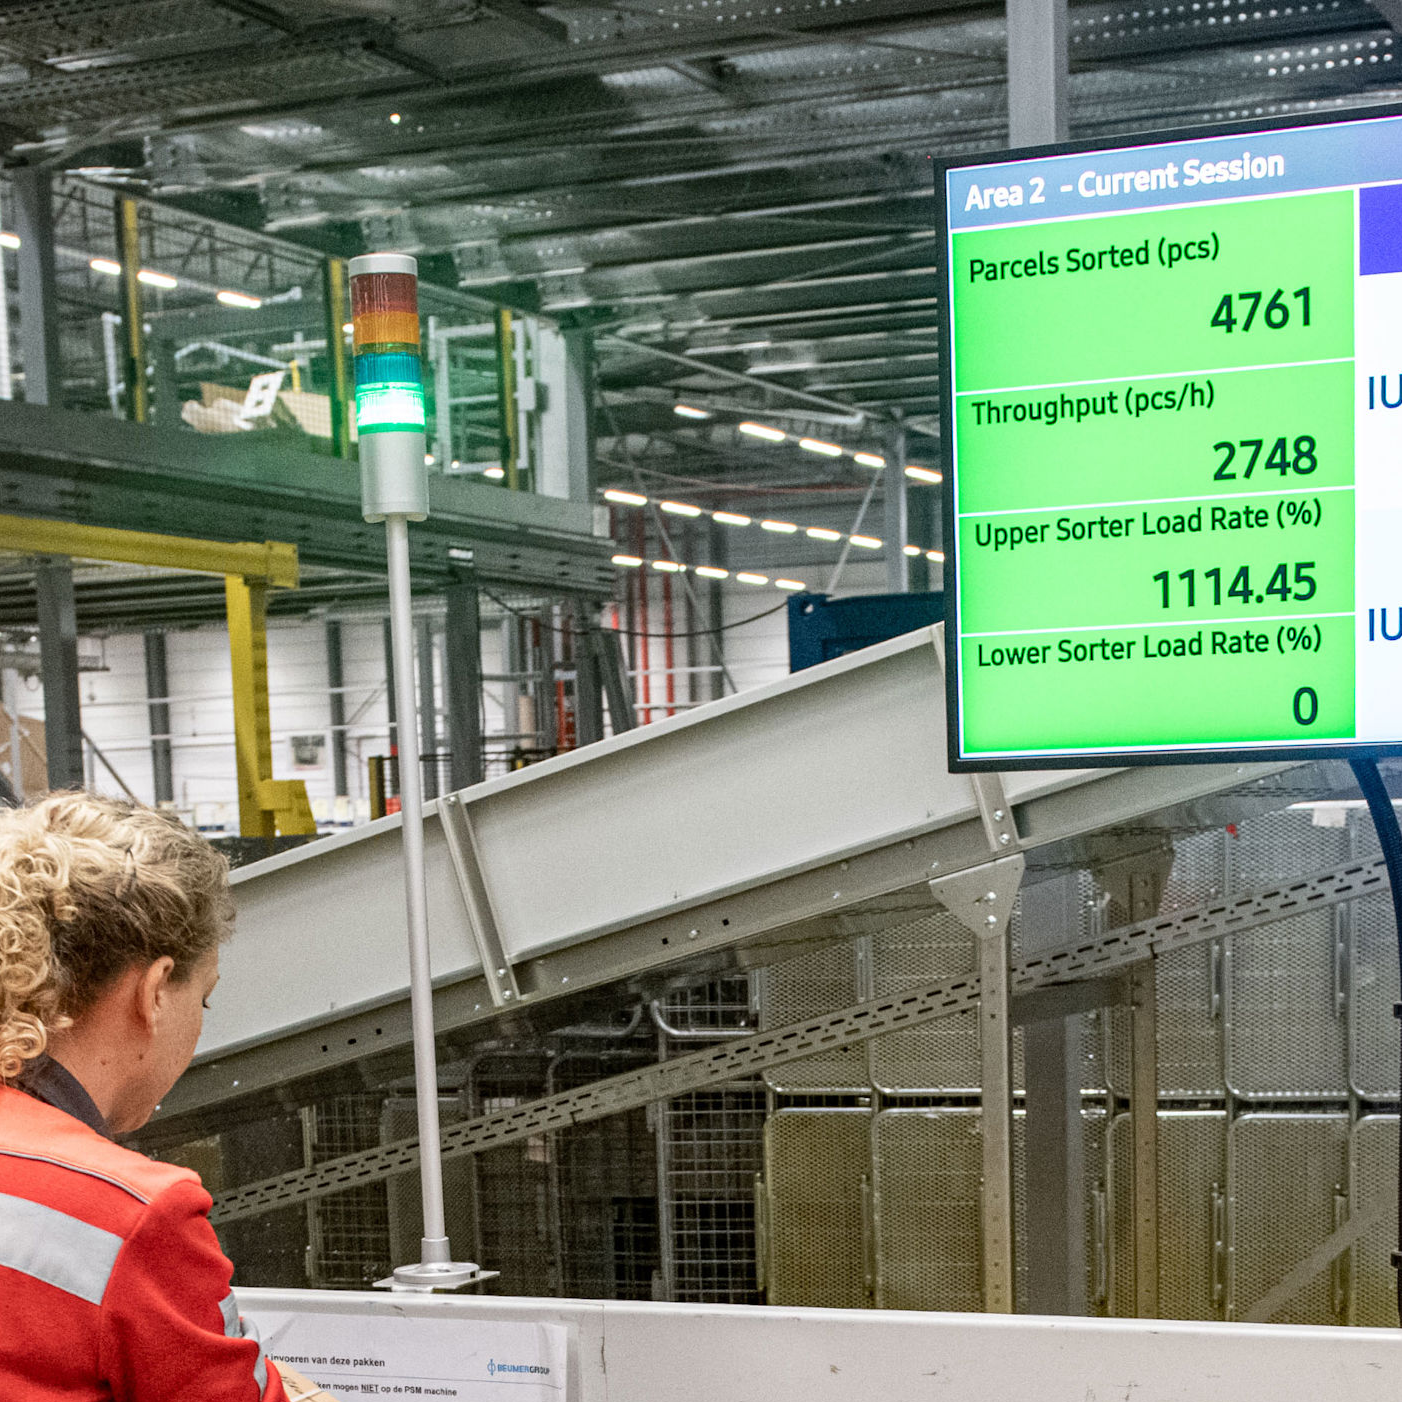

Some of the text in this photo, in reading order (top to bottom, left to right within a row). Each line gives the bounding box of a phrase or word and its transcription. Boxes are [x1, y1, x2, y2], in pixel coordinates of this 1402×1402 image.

[964, 184, 1023, 211] Area
[1029, 178, 1045, 203] 2
[1077, 163, 1178, 198] Current
[1183, 152, 1285, 186] Session
[970, 232, 1220, 282] Parcels Sorted (pcs)
[1209, 287, 1313, 334] 4761
[972, 380, 1214, 425] Throughput (pcs/h)
[1213, 435, 1317, 480] 2748
[976, 498, 1322, 550] Upper Sorter Load Rate (%)
[1153, 562, 1316, 608] 1114.45
[978, 624, 1321, 666] Lower Sorter Load Rate (%)
[1294, 687, 1318, 725] 0
[311, 1356, 328, 1365] van
[330, 1356, 350, 1365] deze
[353, 1358, 386, 1367] pakken
[360, 1384, 379, 1393] NIET
[381, 1385, 391, 1393] op
[393, 1385, 403, 1393] de
[404, 1385, 422, 1394] PSM
[424, 1386, 457, 1396] machine
